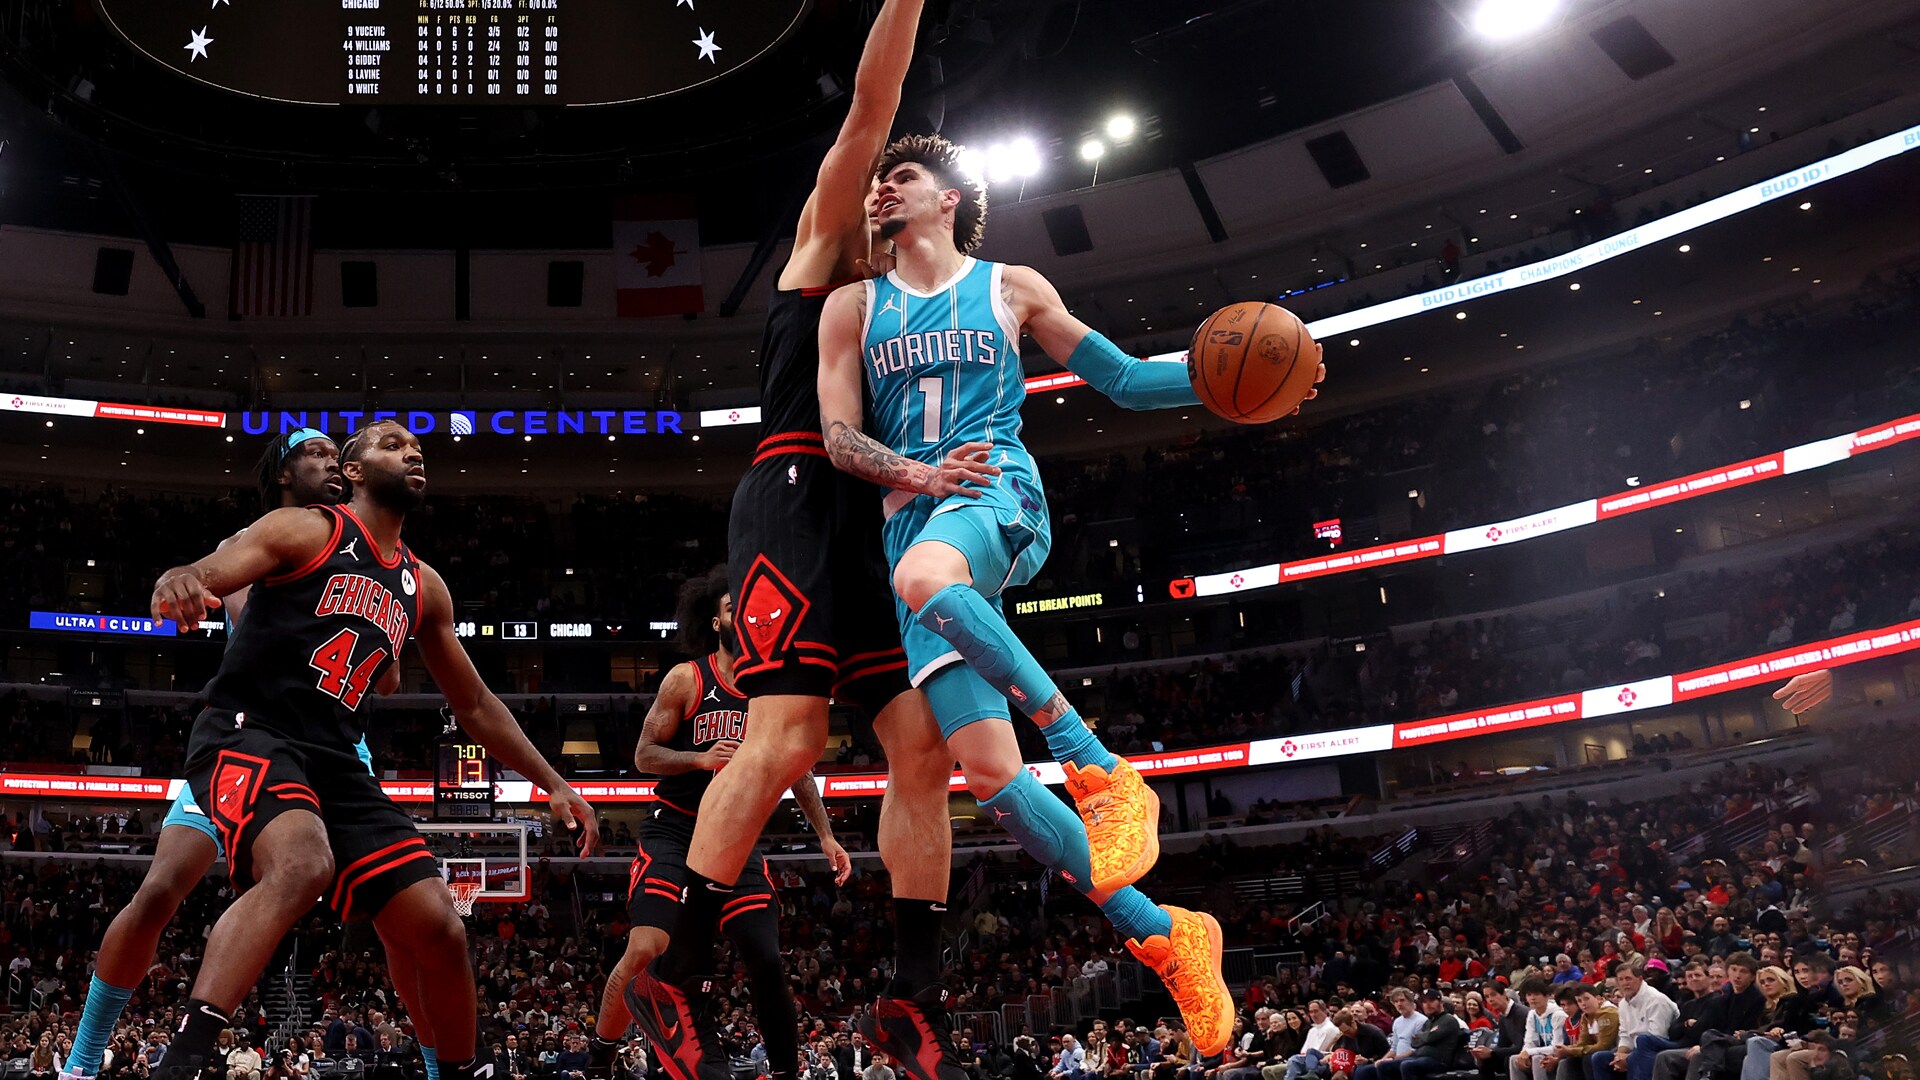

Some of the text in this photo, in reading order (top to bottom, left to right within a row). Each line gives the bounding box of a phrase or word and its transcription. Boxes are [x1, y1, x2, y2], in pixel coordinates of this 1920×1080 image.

[418, 15, 555, 24] MIN F PTS REB FG 3PT FT
[348, 26, 557, 37] 9 VUCEVIC 04 0 6 2 3/5 0/2 0/0
[343, 40, 557, 51] 44 WILLIAMS 04 0 5 0 2/4 1/3 0/0
[348, 55, 557, 65] 3 GIDDEY 04 1 2 2 1/2 0/0 0/0
[348, 69, 557, 80] 8 LAVINE 04 0 0 1 0/1 0/0 0/0
[348, 84, 557, 94] 0 WHITE 04 0 0 0 0/0 0/0 0/0
[1760, 176, 1799, 198] BUD
[1422, 233, 1639, 307] BUD LIGHT CHAMPIONS LOUNGE
[869, 329, 998, 380] HORNETS
[918, 376, 944, 444] 1
[490, 411, 684, 434] CENTER
[1506, 518, 1557, 535] FIRST ALERT
[1016, 593, 1103, 615] FAST BREAK POINTS
[56, 616, 152, 632] ULTRA CLUB
[314, 574, 409, 660] CHICAGO
[453, 622, 475, 637] :08
[514, 624, 527, 637] 13
[550, 624, 592, 637] CHICAGO
[308, 627, 388, 712] 44
[1301, 737, 1360, 750] FIRST ALERT
[453, 744, 486, 759] 7:07
[458, 760, 483, 786] 13
